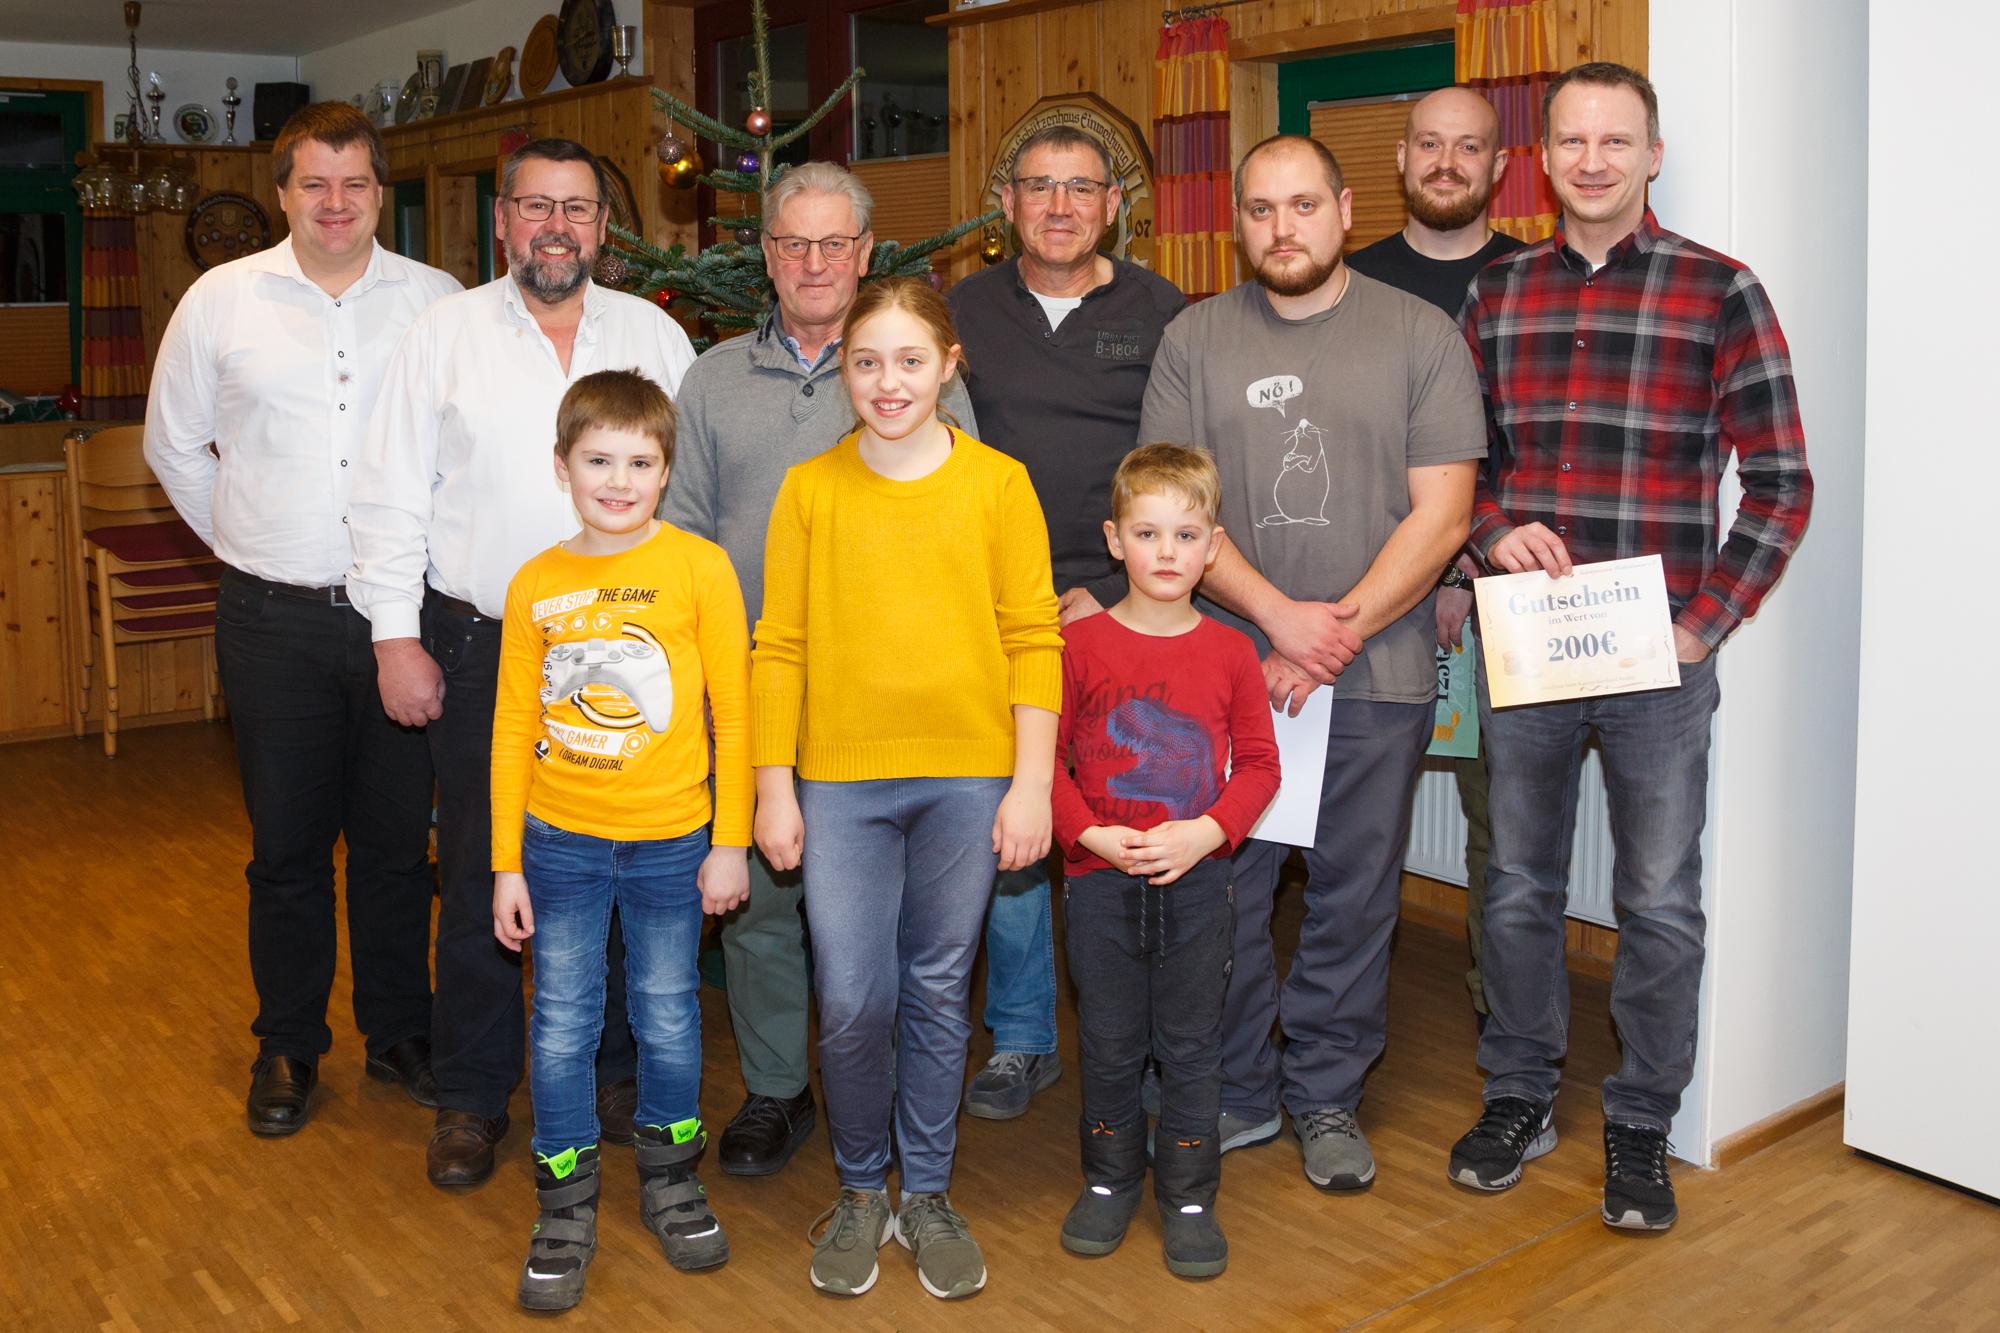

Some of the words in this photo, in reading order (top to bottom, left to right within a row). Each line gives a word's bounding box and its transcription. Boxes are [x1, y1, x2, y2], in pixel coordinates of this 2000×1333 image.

[1080, 112, 1130, 169] Einweihung
[1134, 219, 1152, 239] 07
[1095, 340, 1140, 357] B-1804
[565, 590, 595, 610] STOP
[596, 588, 622, 603] THE
[621, 587, 660, 604] GAME
[1507, 580, 1642, 616] Gutschein
[1548, 616, 1562, 626] im
[1563, 613, 1588, 624] Wert
[1589, 611, 1608, 620] von
[1547, 630, 1619, 662] 200€
[566, 730, 609, 750] GAMER
[562, 751, 589, 767] DREAM
[589, 757, 624, 771] DIGITAL
